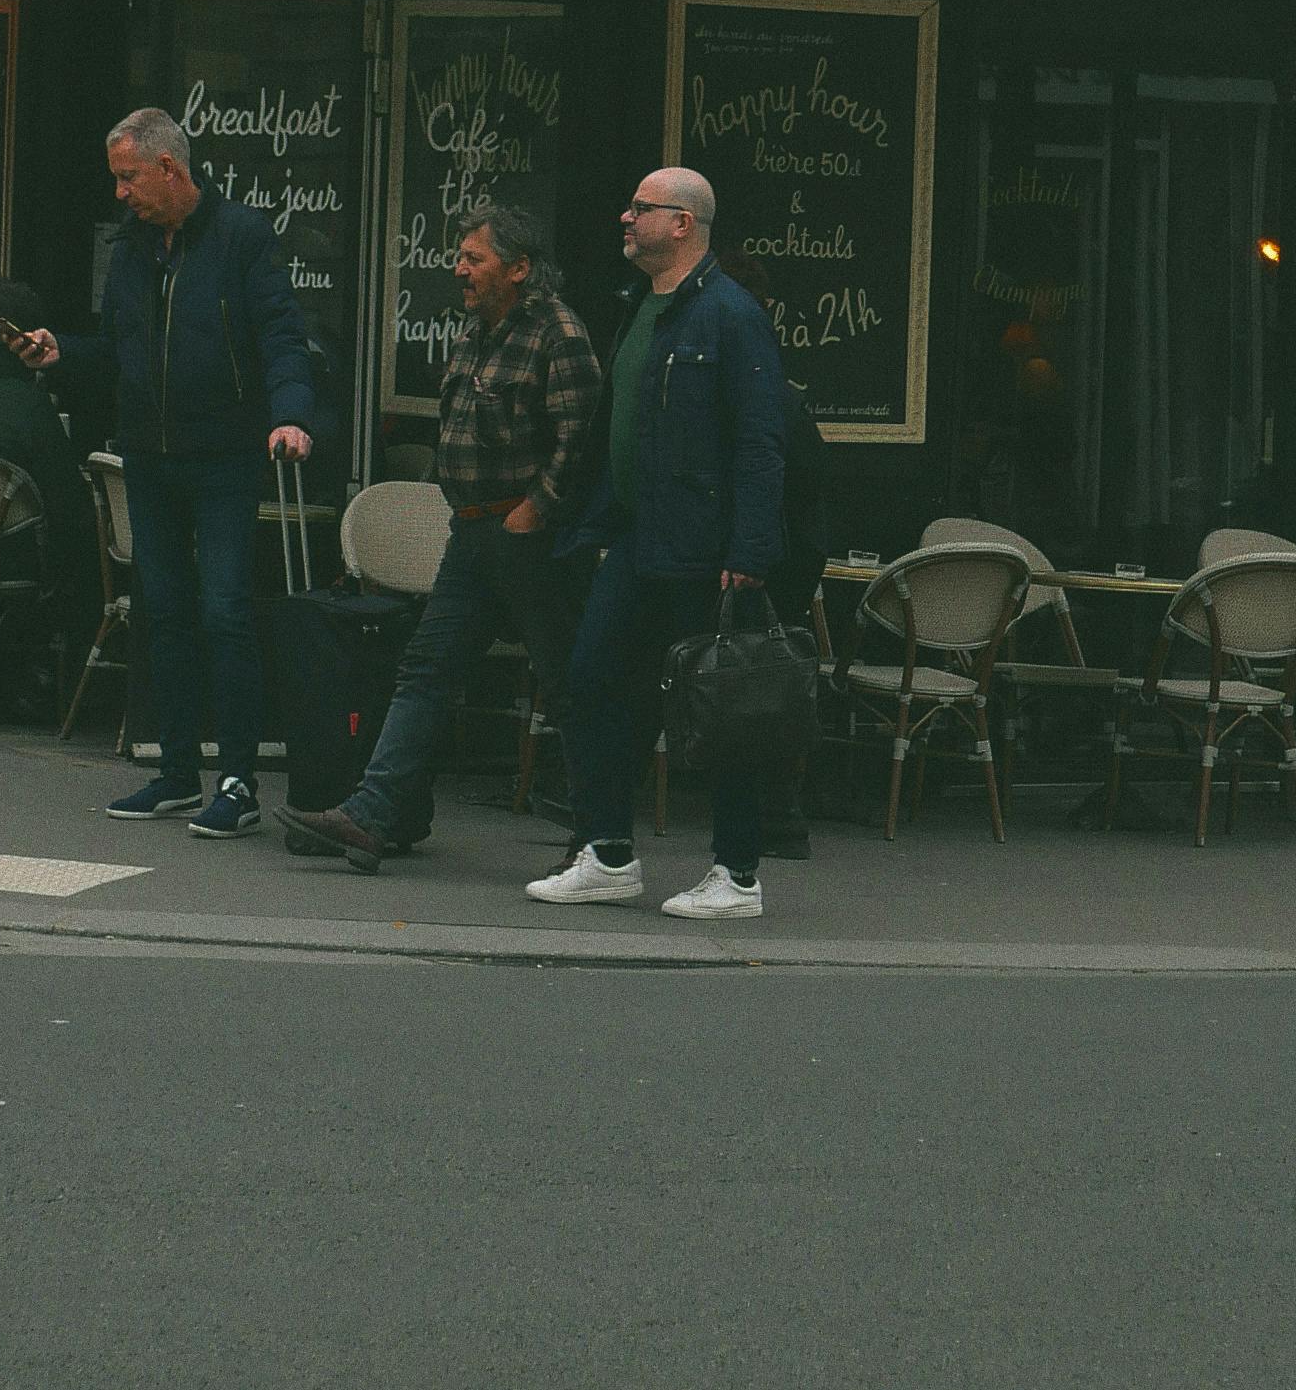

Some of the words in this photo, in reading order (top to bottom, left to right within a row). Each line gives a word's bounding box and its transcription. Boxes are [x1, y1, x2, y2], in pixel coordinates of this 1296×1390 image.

[180, 79, 343, 157] breakfast
[690, 74, 802, 148] happy
[806, 56, 889, 147] hour
[427, 101, 505, 173] Café
[752, 136, 816, 175] bière
[272, 167, 343, 236] jour
[789, 189, 806, 215] &
[742, 222, 856, 260] cocktails
[791, 311, 812, 348] à
[816, 287, 883, 346] 21h
